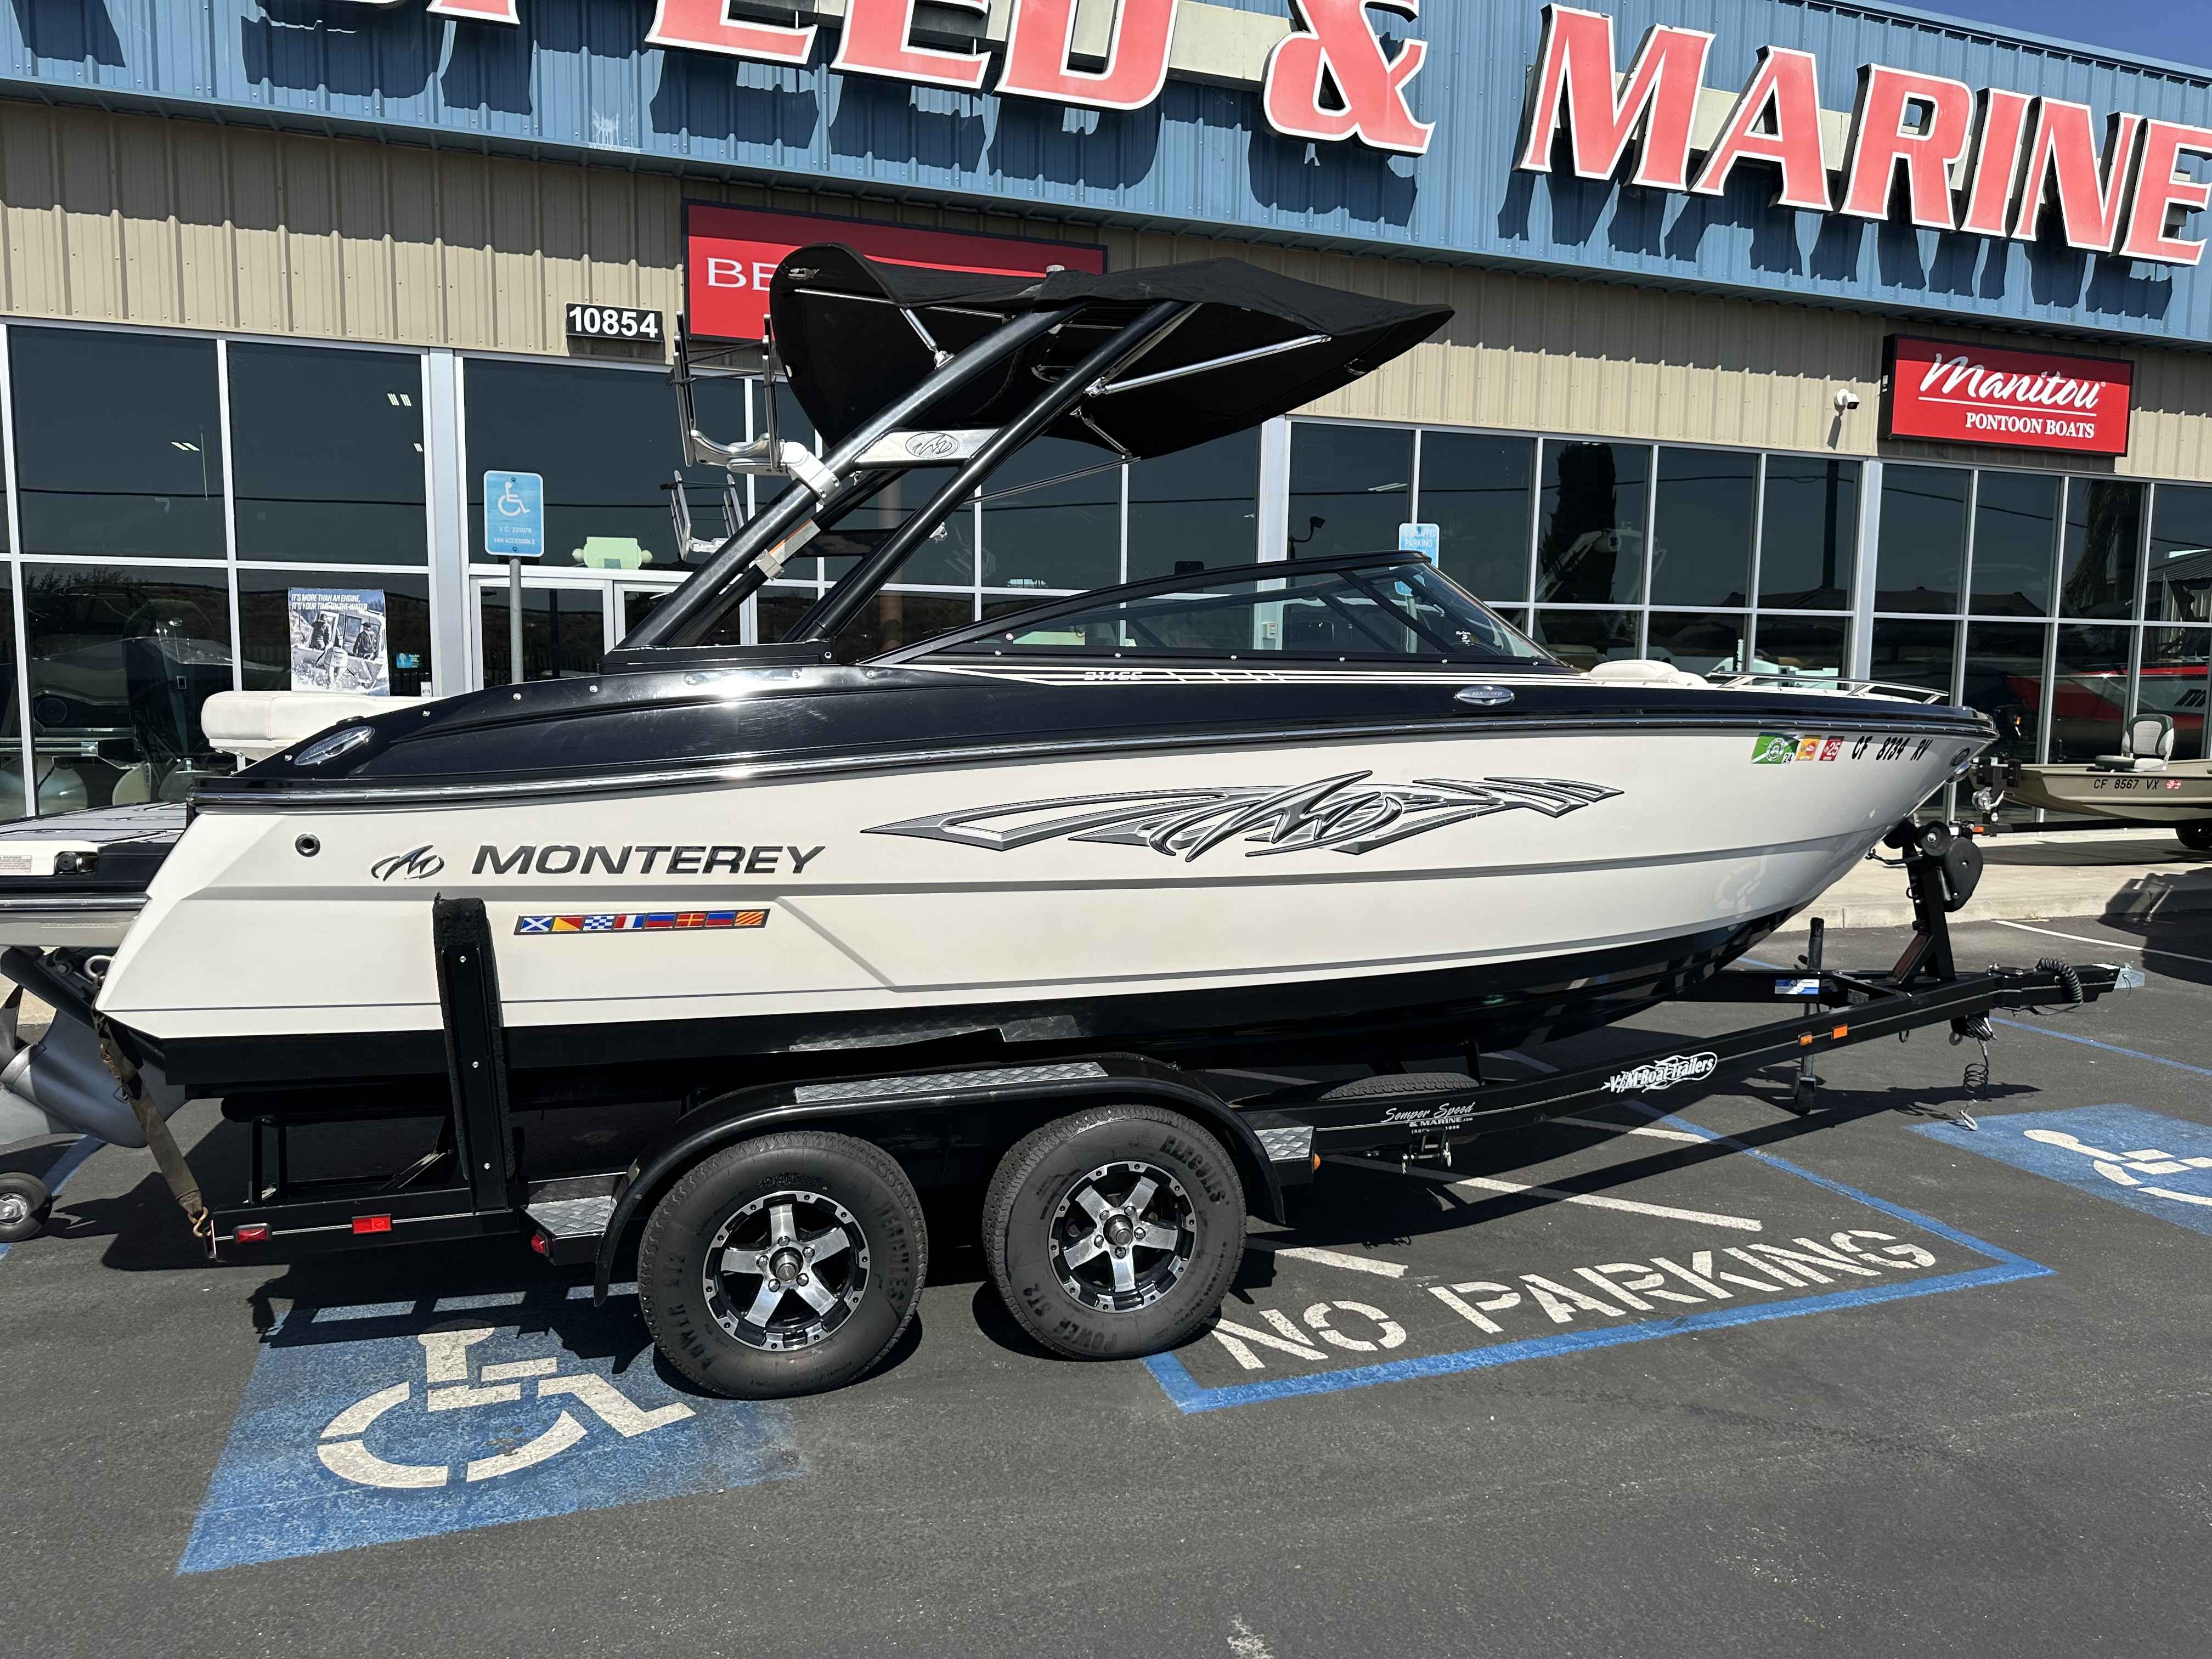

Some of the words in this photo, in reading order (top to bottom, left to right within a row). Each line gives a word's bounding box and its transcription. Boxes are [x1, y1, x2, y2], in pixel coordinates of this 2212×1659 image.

[1263, 0, 1436, 155] &
[1517, 3, 2212, 266] MARINE
[569, 307, 658, 338] 10854
[1920, 353, 2099, 410] Manitou
[1966, 412, 2043, 435] PONTOON
[2045, 418, 2095, 439] BOATS
[1404, 539, 1432, 548] PARKING
[301, 594, 318, 602] MORE
[318, 594, 332, 602] THAN
[332, 594, 340, 602] AN
[1783, 753, 1793, 763] 24
[1826, 741, 1841, 756] 25
[1852, 736, 1873, 759] CF
[2094, 779, 2108, 789] CF
[2114, 779, 2139, 789] 8567
[2147, 779, 2159, 789] VX
[471, 844, 826, 874] MONTEREY
[1640, 1066, 1669, 1085] Boat
[1670, 1057, 1714, 1078] Trailers
[1380, 1108, 1431, 1123] Semper
[1434, 1102, 1476, 1119] Speed
[1210, 1300, 1406, 1369] NO
[1429, 1229, 1936, 1333] PARKING
